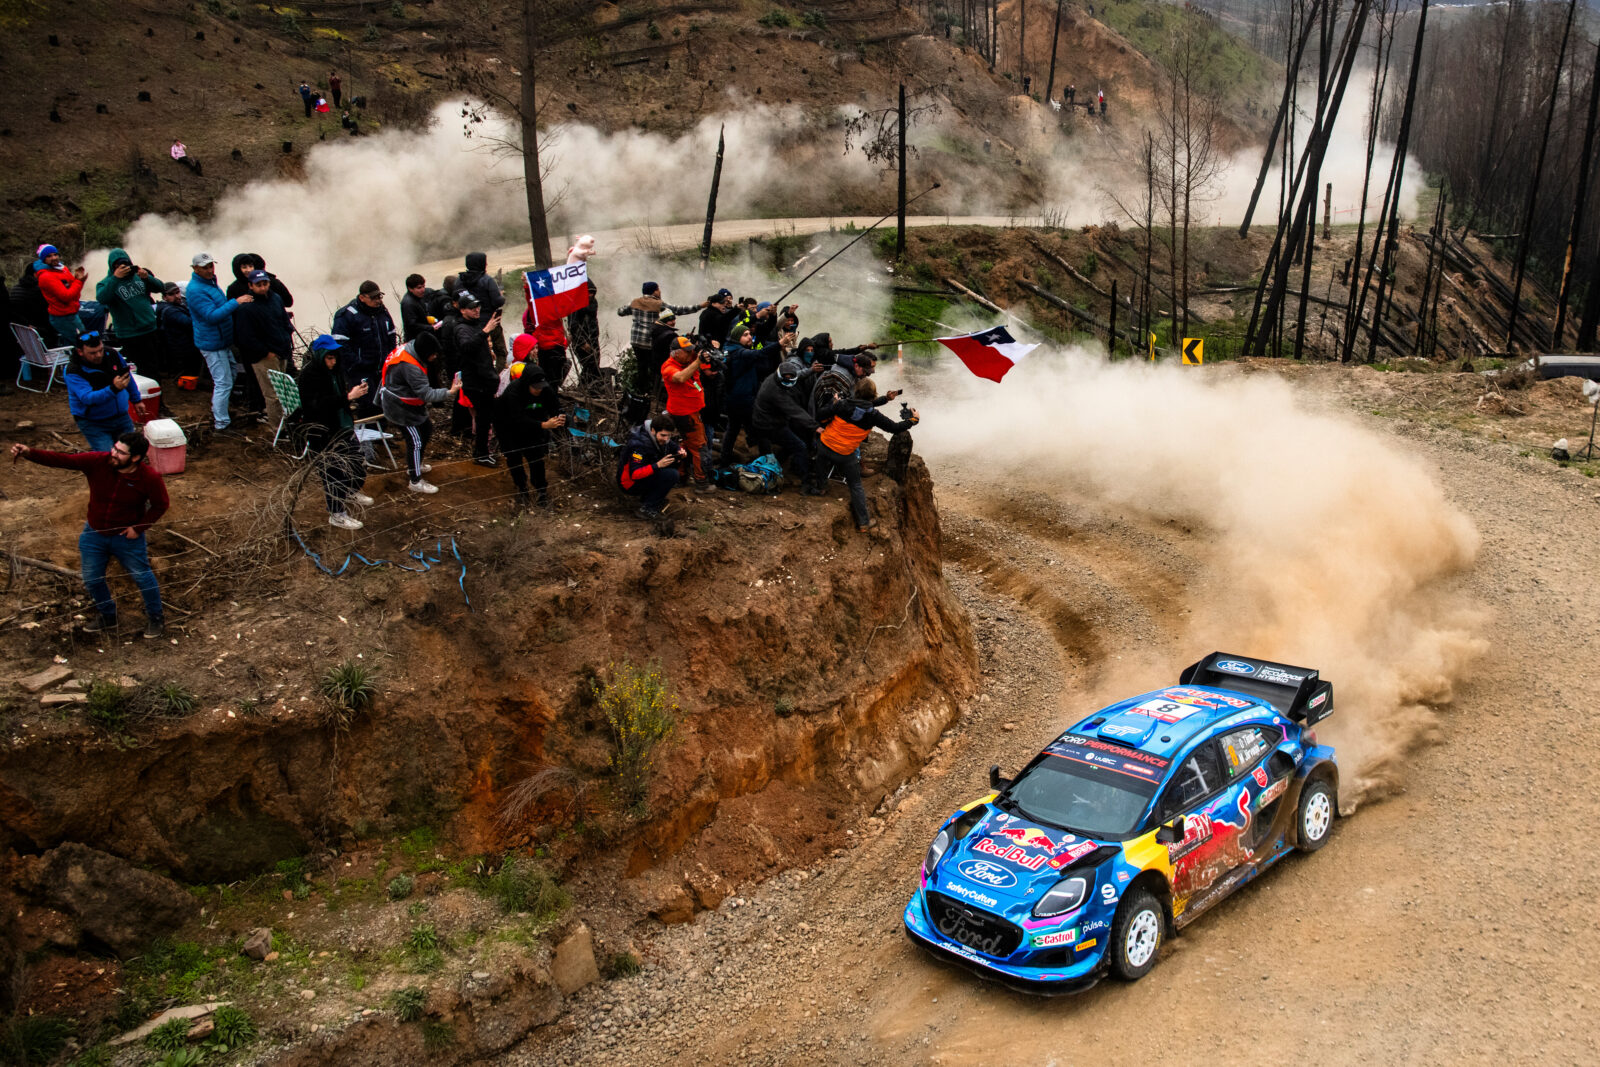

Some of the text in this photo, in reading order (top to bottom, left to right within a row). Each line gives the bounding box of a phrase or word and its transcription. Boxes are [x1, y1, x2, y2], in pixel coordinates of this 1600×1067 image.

[1156, 703, 1181, 712] 8
[1059, 735, 1087, 745] FORD
[1083, 739, 1169, 768] PERFORMANCE
[1228, 745, 1239, 766] 8
[972, 838, 1016, 859] Red
[1004, 845, 1048, 871] Bull
[965, 861, 1009, 885] Ford
[946, 881, 998, 906] SafetyCulture
[939, 908, 1003, 956] Ford
[1044, 930, 1073, 945] Castrol
[1082, 920, 1104, 934] pulse
